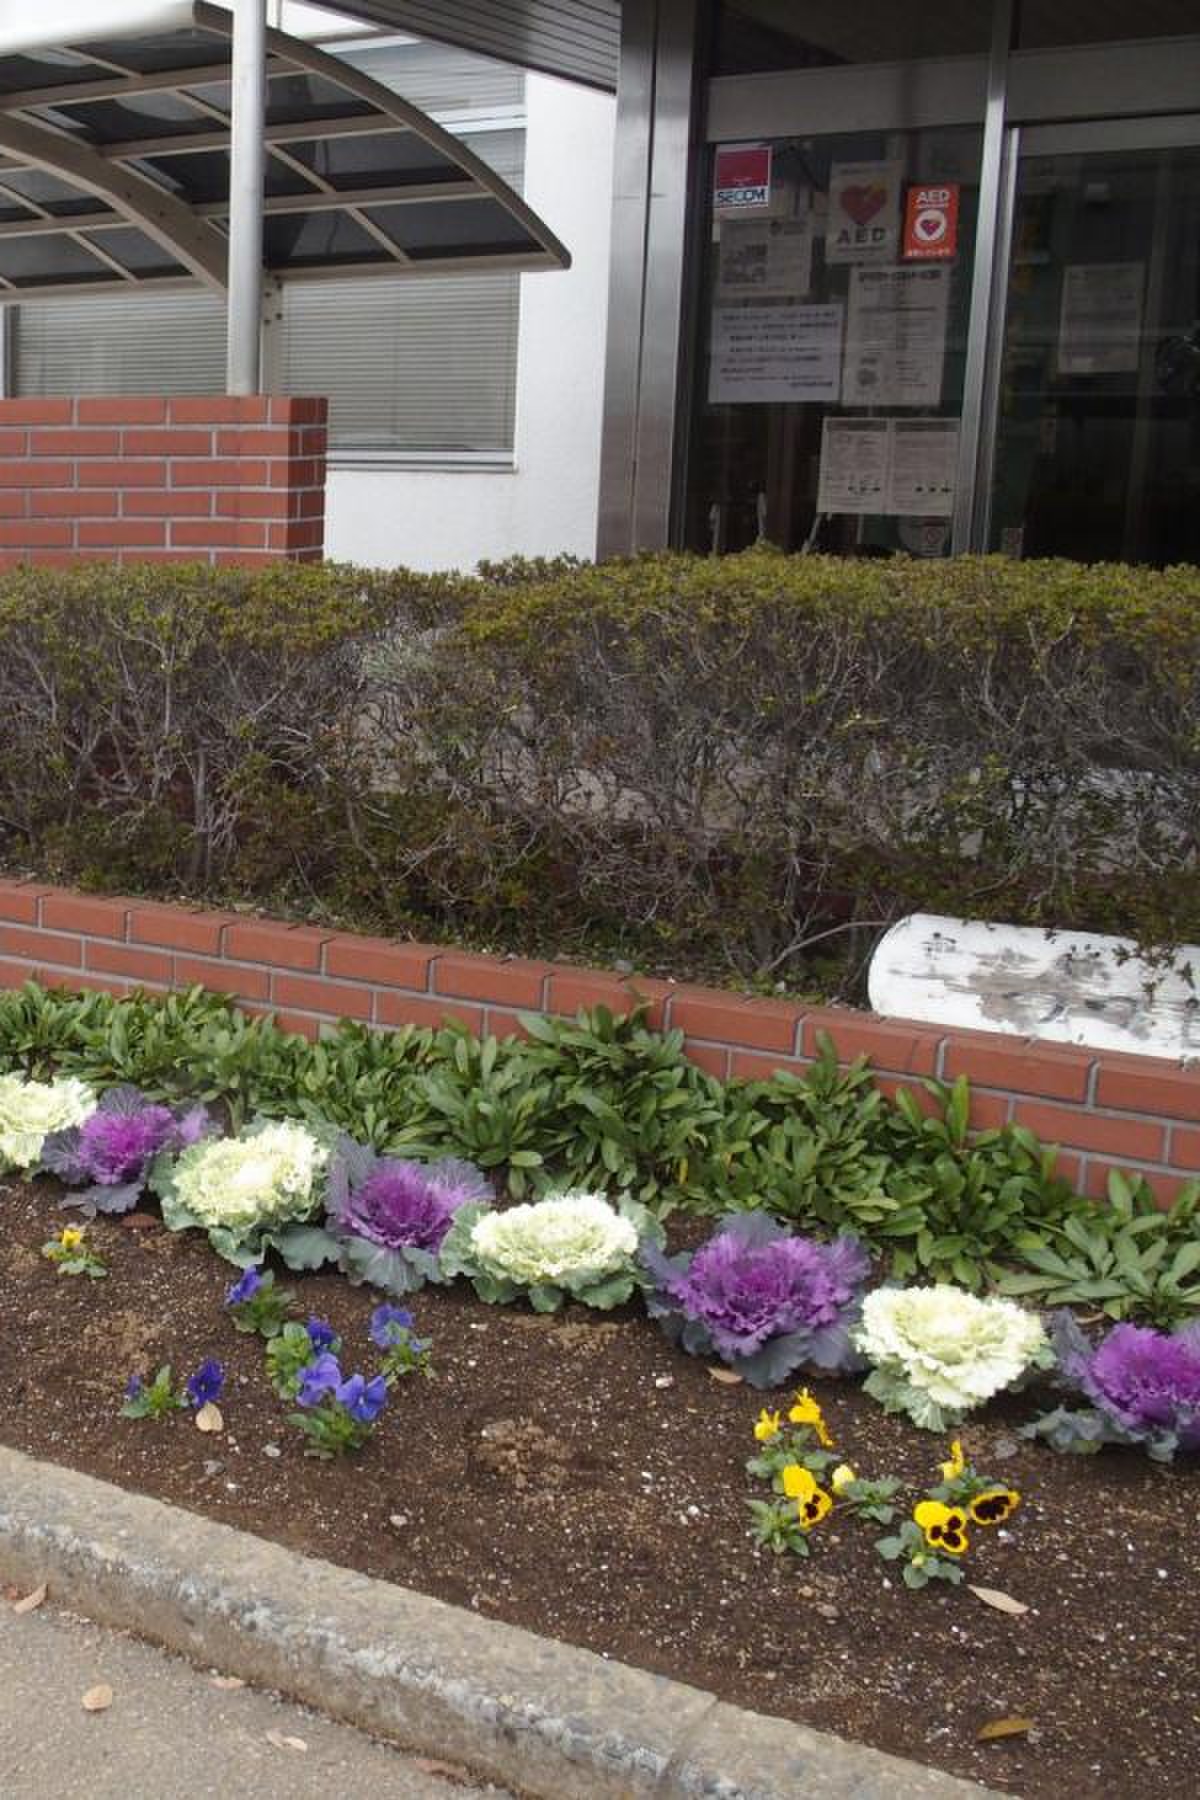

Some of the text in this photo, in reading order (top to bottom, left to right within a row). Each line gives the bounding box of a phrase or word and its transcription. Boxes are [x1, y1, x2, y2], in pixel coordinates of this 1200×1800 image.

[717, 188, 766, 202] SECOM
[916, 190, 950, 204] AED
[837, 227, 887, 244] AED
